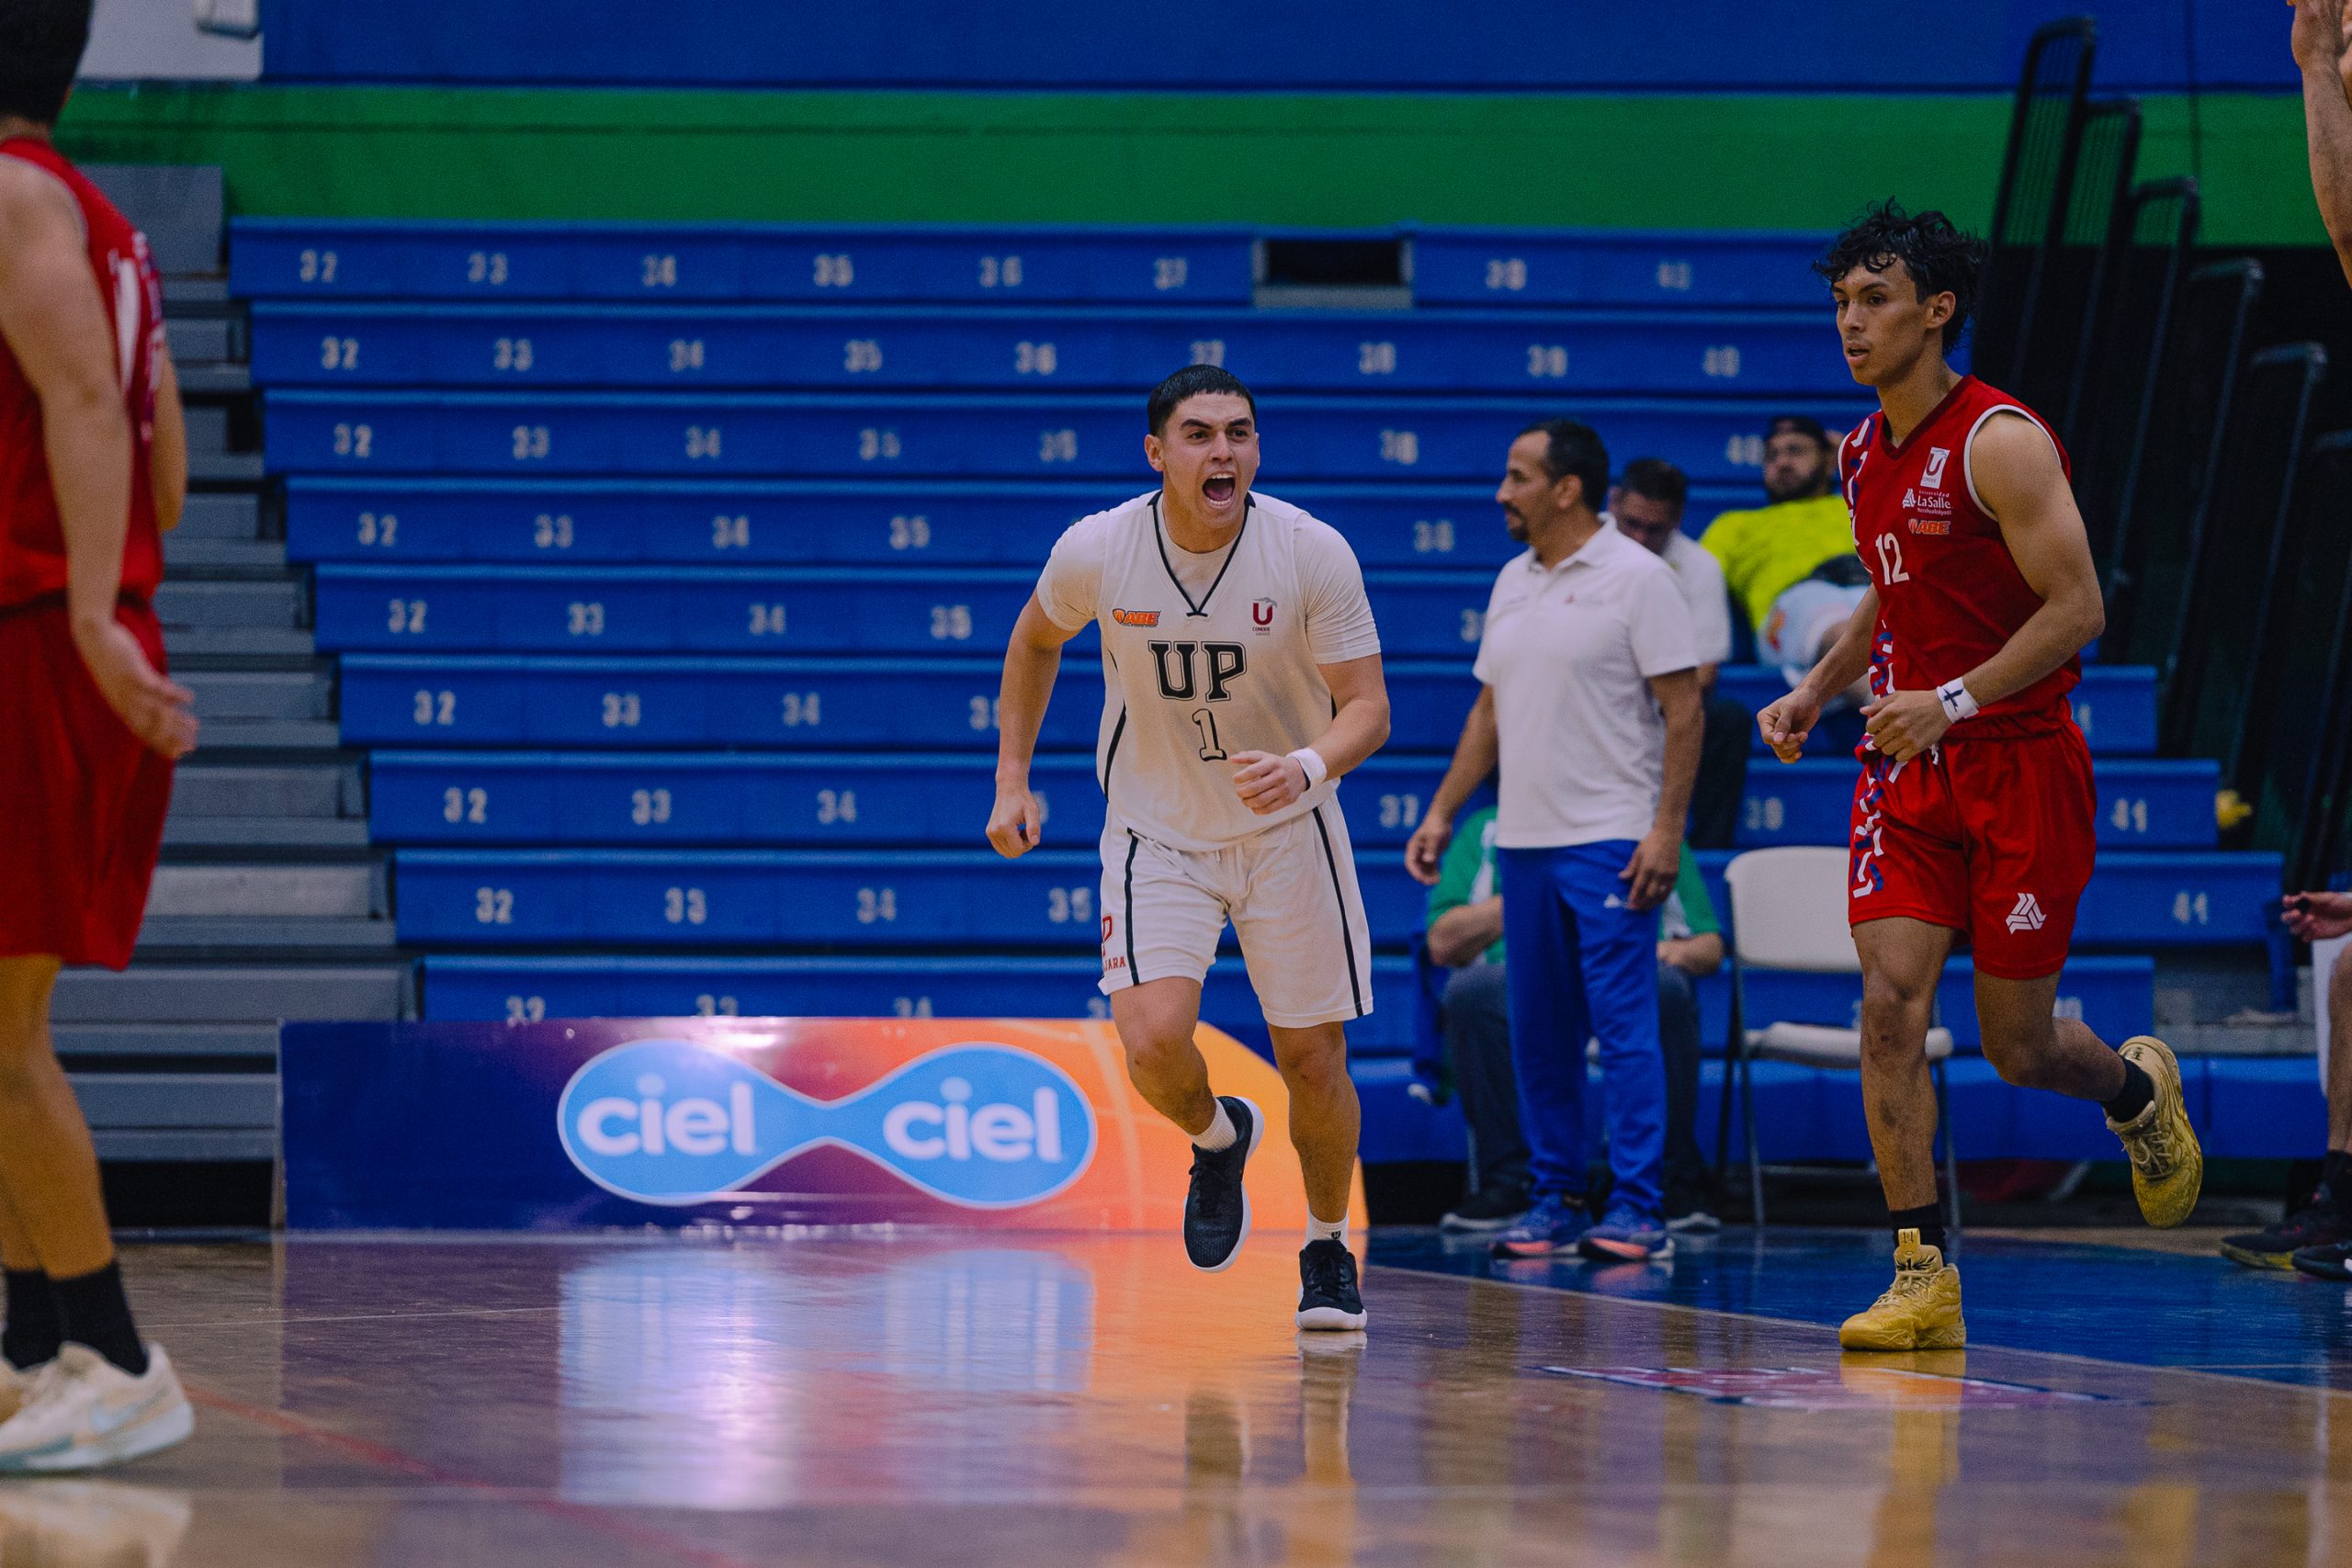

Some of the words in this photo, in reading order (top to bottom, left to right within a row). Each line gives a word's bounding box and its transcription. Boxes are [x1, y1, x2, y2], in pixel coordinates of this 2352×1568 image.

[300, 249, 337, 283] 32
[468, 252, 508, 285] 33
[322, 337, 359, 369] 32
[494, 338, 533, 372] 33
[334, 423, 372, 457] 32
[513, 425, 549, 459] 33
[357, 513, 398, 547] 32
[534, 514, 573, 548] 33
[1916, 520, 1951, 535] ABE
[1875, 532, 1909, 585] 12
[388, 599, 427, 634] 32
[569, 603, 604, 635] 33
[1123, 611, 1160, 626] ABE
[1148, 640, 1248, 702] UP
[413, 690, 456, 725] 32
[602, 693, 641, 728] 33
[1192, 708, 1227, 761] 1
[444, 787, 488, 824] 32
[631, 789, 672, 826] 33
[2111, 798, 2147, 832] 41
[475, 886, 514, 924] 32
[664, 887, 707, 925] 33
[1048, 886, 1091, 923] 35
[2173, 892, 2208, 923] 41
[577, 1072, 758, 1157] ciel
[881, 1077, 1064, 1164] ciel
